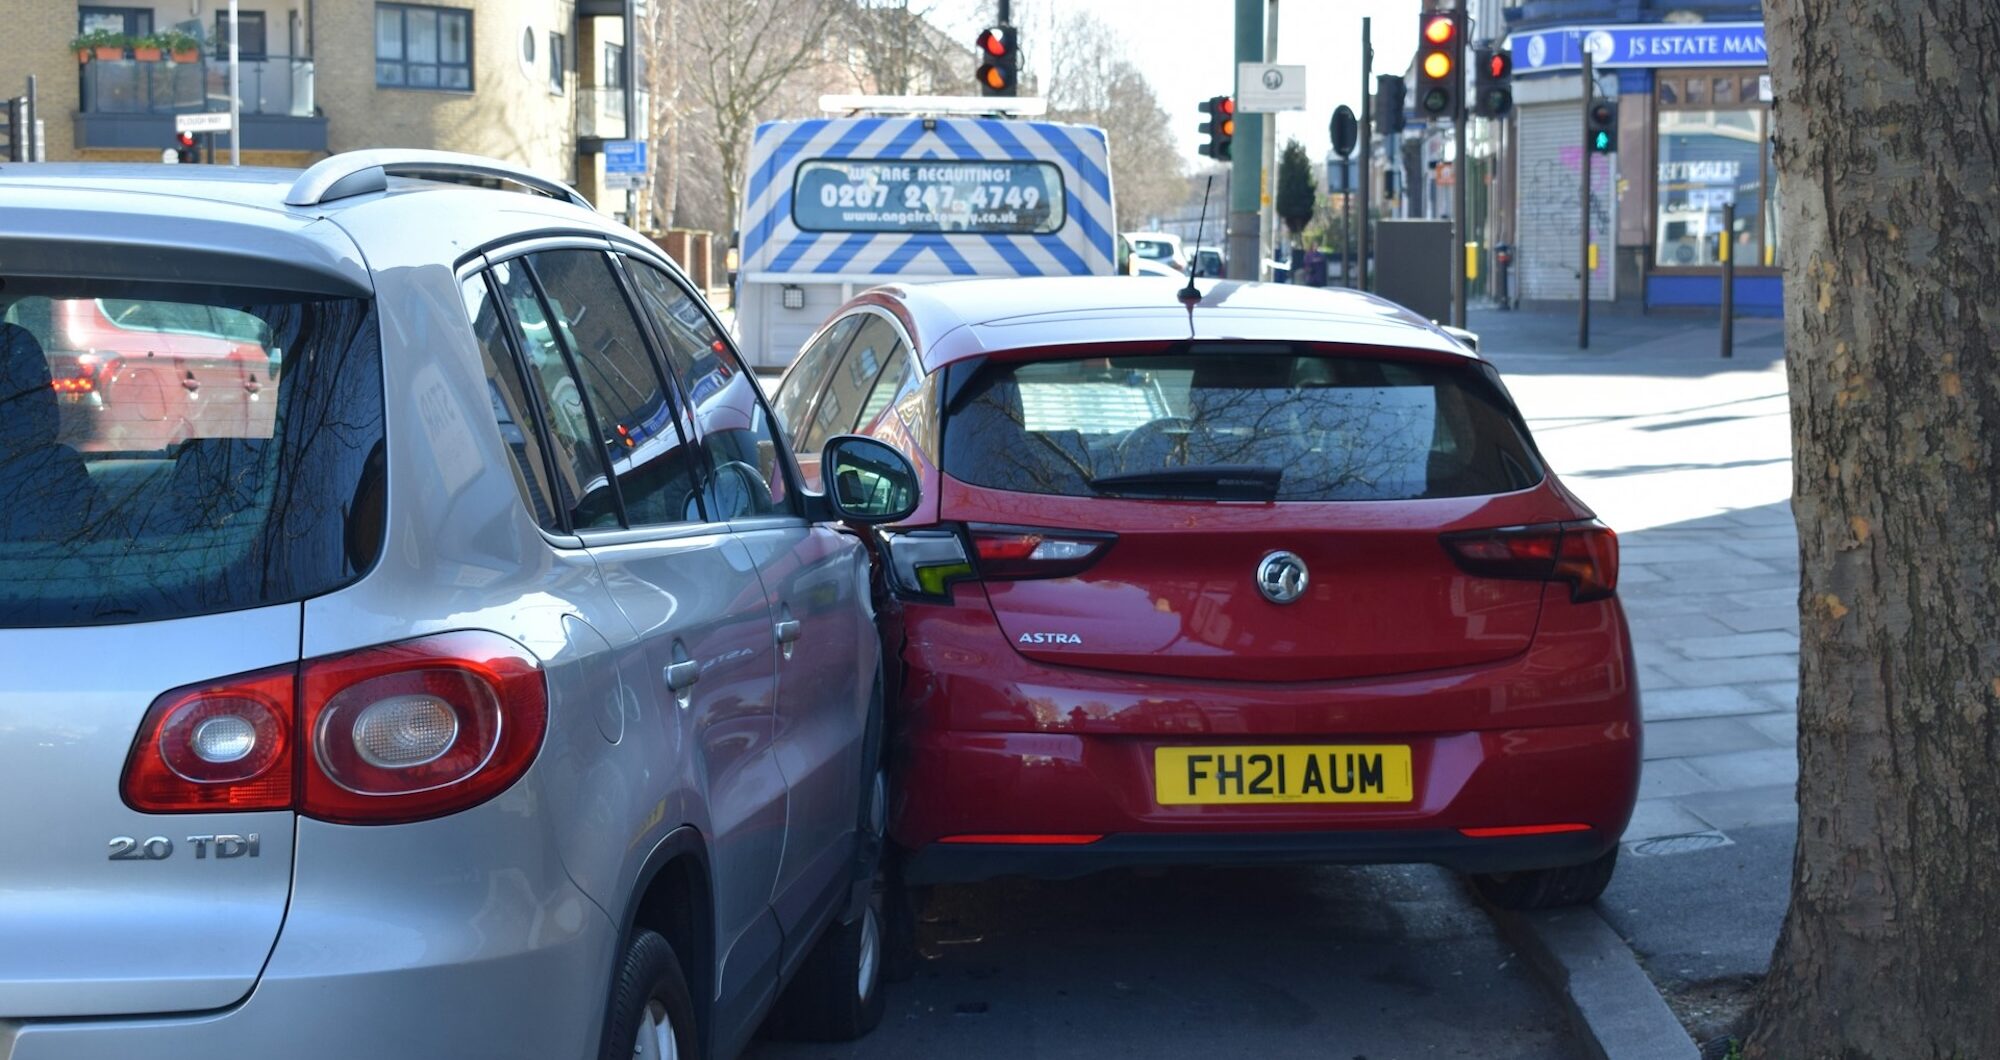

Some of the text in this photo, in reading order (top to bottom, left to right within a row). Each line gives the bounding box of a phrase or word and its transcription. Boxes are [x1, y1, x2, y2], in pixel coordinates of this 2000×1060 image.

[1628, 36, 1647, 58] JS
[1650, 35, 1718, 55] ESTATE
[881, 167, 911, 181] ARE
[917, 167, 1011, 182] RECRUITING!
[821, 183, 1040, 210] 0207 247 4749
[842, 209, 1018, 225] www.angelrecoy.co.uk
[1019, 632, 1082, 644] ASTRA
[1187, 754, 1286, 796] FH21
[1301, 753, 1384, 794] AUM
[108, 833, 261, 861] 2.0 TDI
